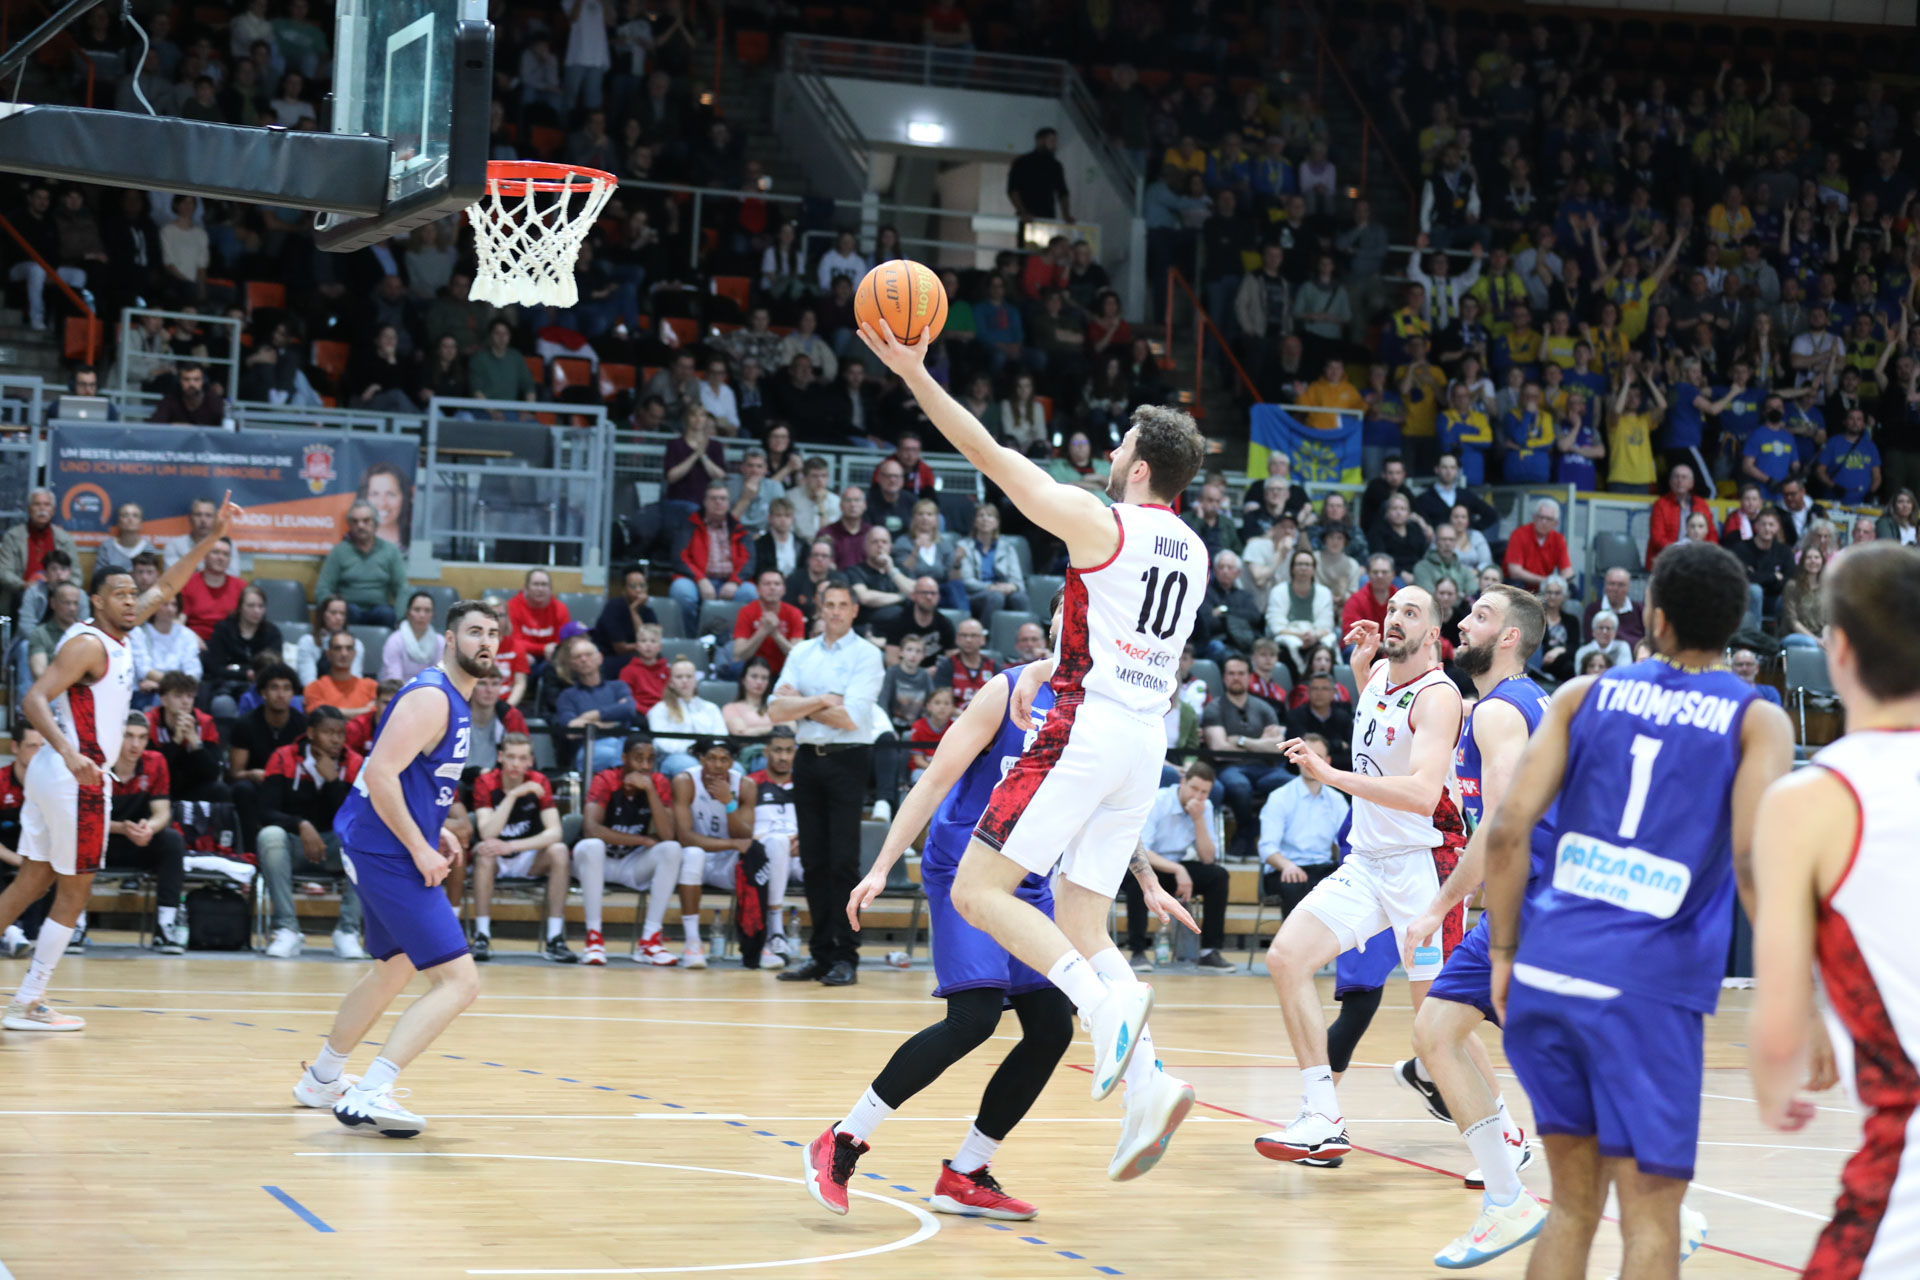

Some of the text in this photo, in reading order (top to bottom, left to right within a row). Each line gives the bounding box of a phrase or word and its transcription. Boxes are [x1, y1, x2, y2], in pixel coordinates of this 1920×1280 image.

[913, 263, 933, 317] Wilson
[60, 447, 78, 459] UM
[80, 447, 111, 460] BESTE
[112, 449, 195, 463] UNTERHALTUNG
[250, 454, 274, 467] SICH
[275, 455, 293, 468] DIE
[60, 460, 91, 474] UND
[93, 462, 117, 474] ICH
[118, 462, 154, 476] MICH
[155, 463, 177, 477] UM
[180, 464, 209, 478] IHRE
[274, 513, 334, 529] LEUNING
[1154, 534, 1189, 562] HUJIĆ
[1135, 566, 1188, 640] 10
[1596, 677, 1739, 736] THOMPSON
[1363, 717, 1377, 748] 8
[1618, 733, 1663, 840] 1
